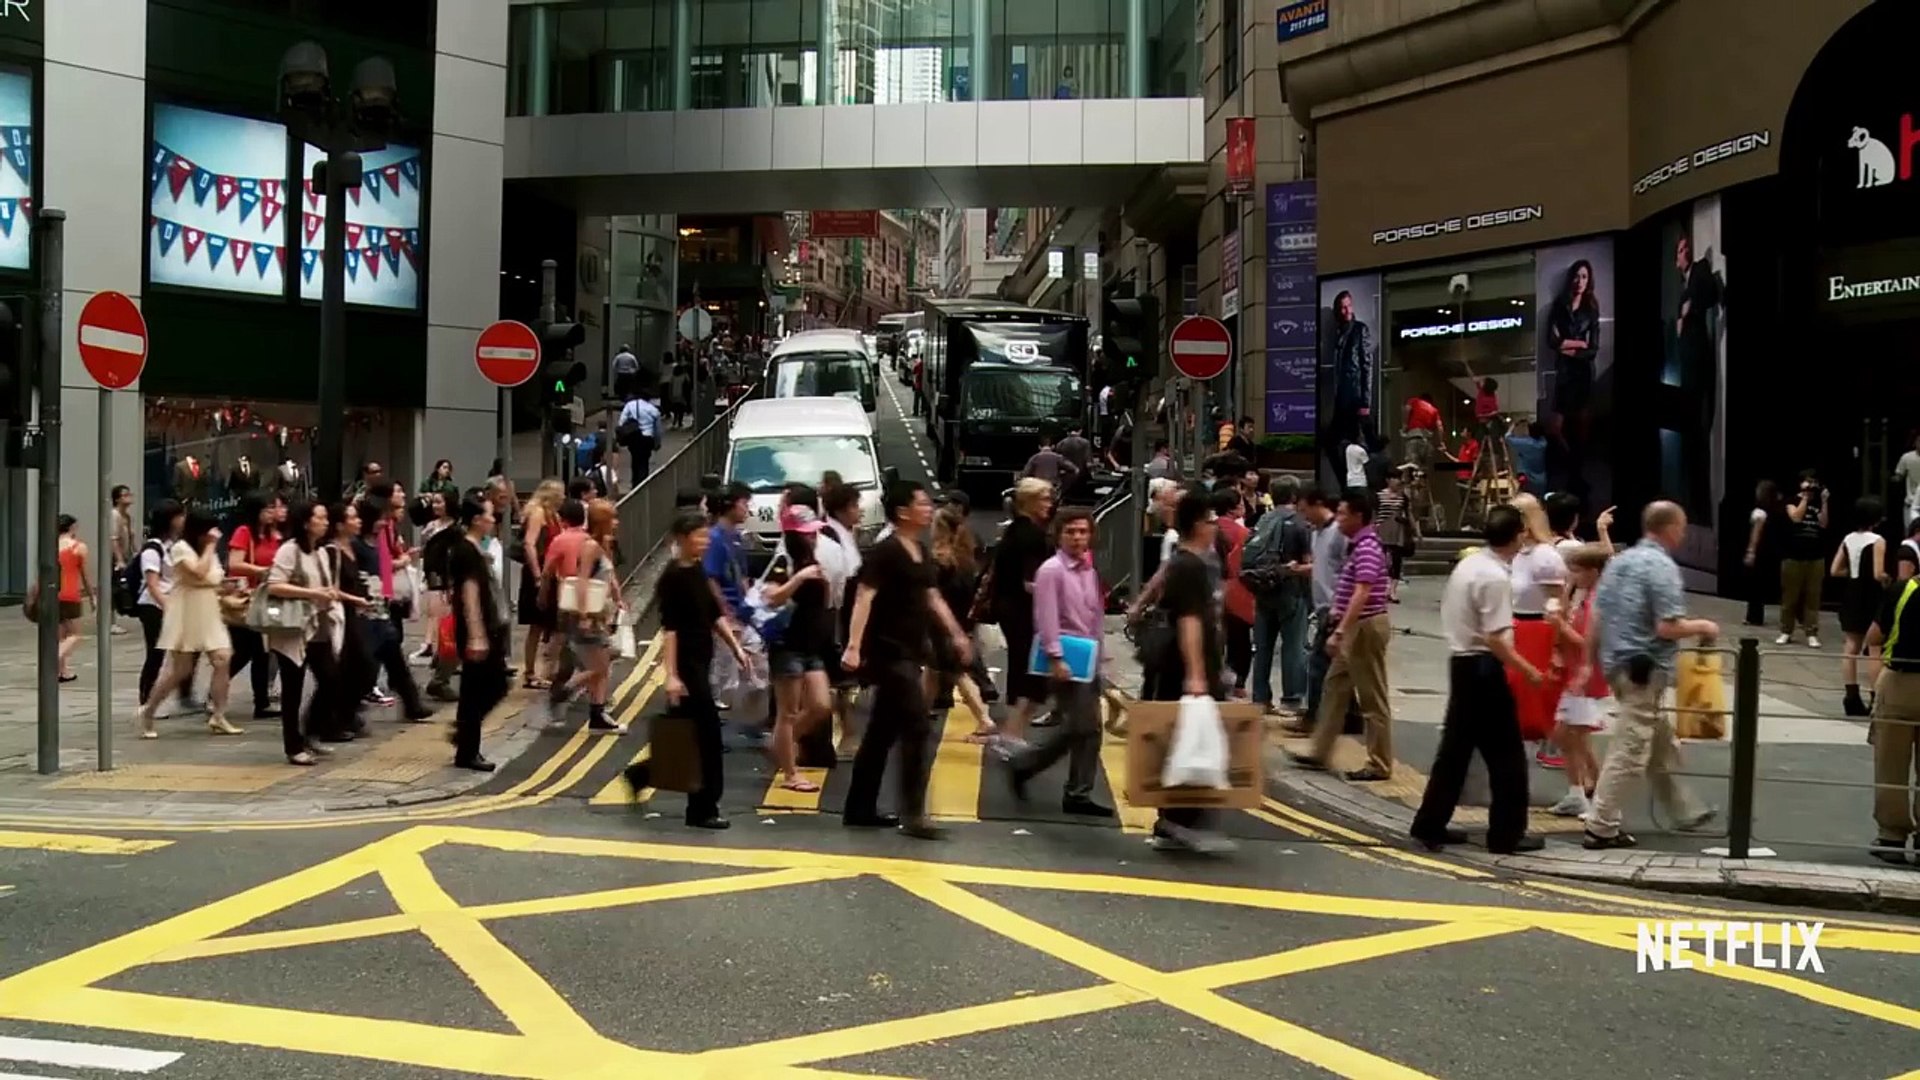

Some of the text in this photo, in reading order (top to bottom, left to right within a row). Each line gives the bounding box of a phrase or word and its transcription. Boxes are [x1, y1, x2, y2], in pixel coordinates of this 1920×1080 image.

[1279, 0, 1325, 25] AVANTI
[1633, 131, 1769, 195] PORSCHE DESIGN
[1373, 205, 1542, 245] PORSCHE DESIGN
[1401, 317, 1522, 339] PORSCHE DESIGN
